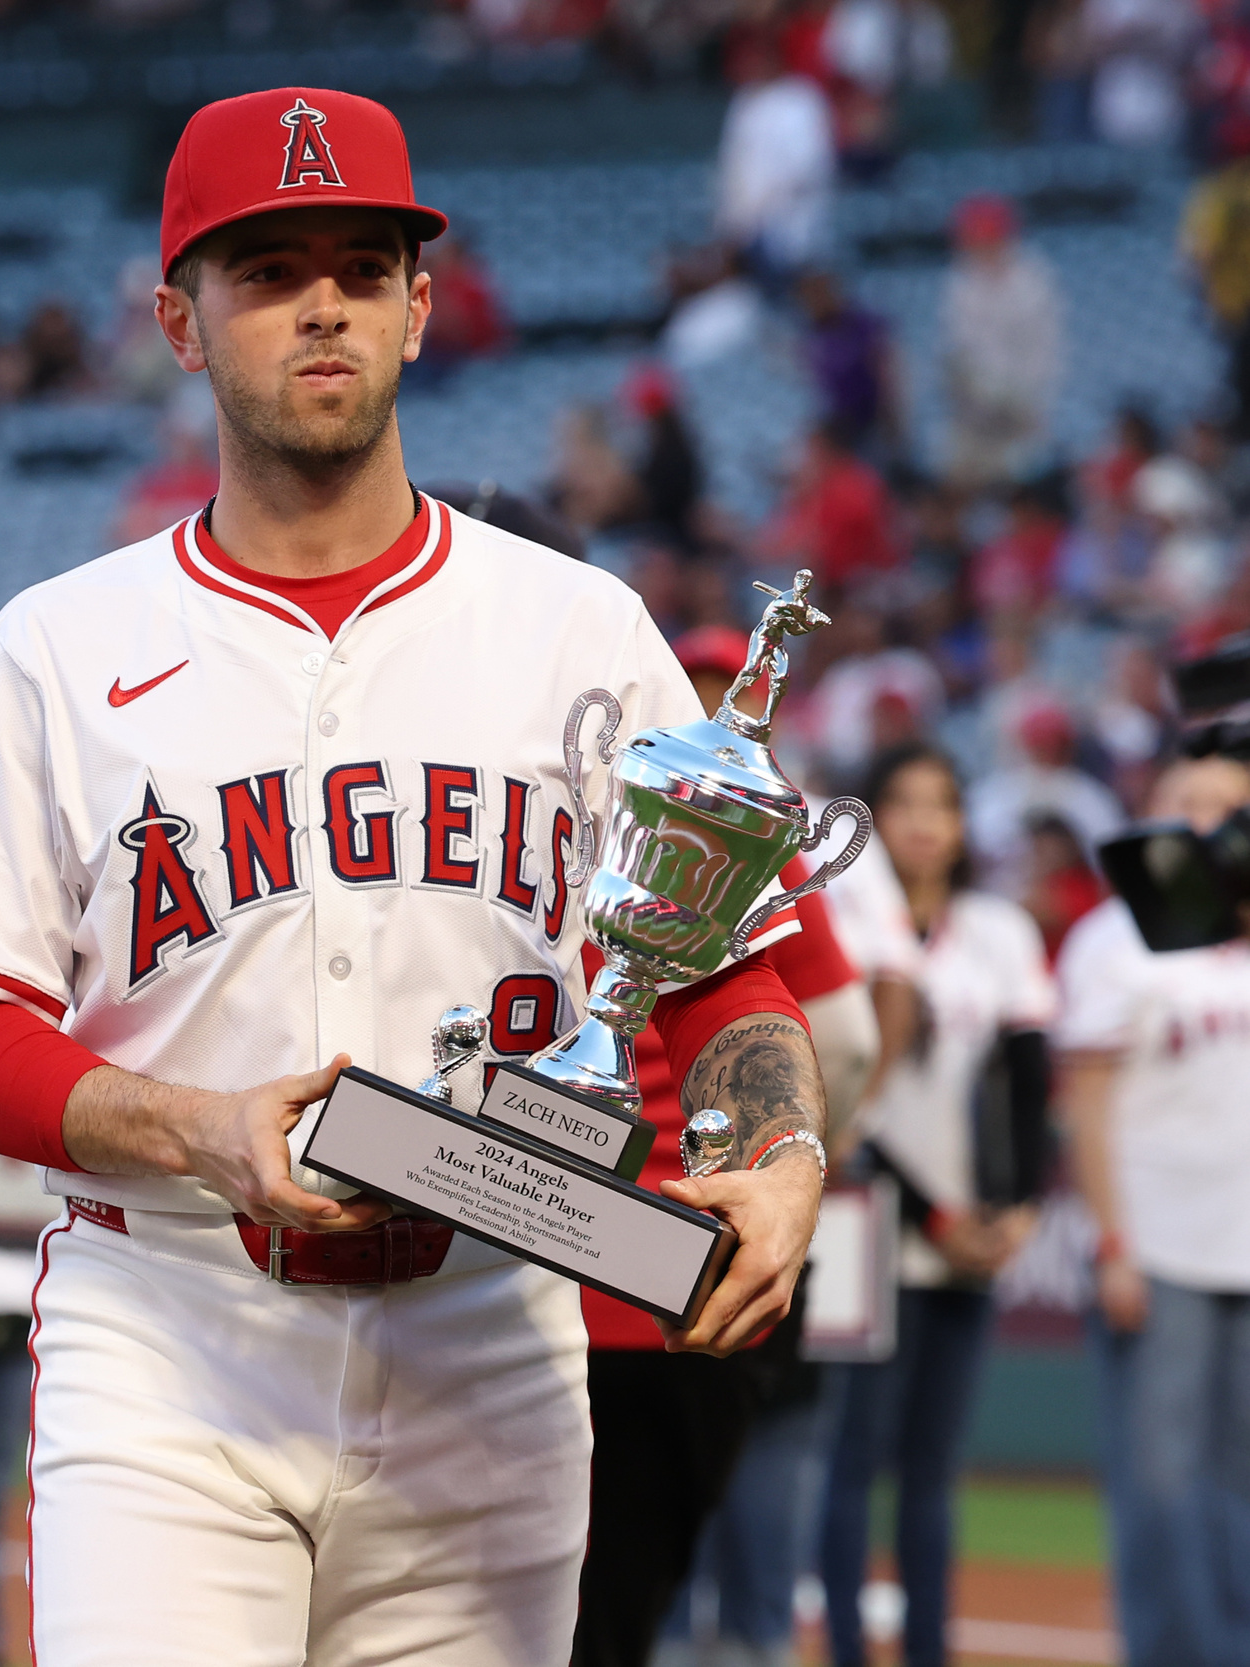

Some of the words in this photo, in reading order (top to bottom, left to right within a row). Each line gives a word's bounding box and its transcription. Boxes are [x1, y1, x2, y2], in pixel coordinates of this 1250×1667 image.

[276, 98, 347, 190] A
[117, 768, 576, 994] ANGELS
[502, 1091, 557, 1126] ZACH
[557, 1113, 609, 1147] NETO
[422, 1165, 460, 1186] Awarded
[460, 1180, 481, 1196] Each
[482, 1189, 511, 1208] Season
[512, 1203, 522, 1213] to
[523, 1207, 536, 1219] the
[537, 1213, 565, 1231] Angels
[566, 1225, 592, 1242] Player
[434, 1145, 477, 1175] Most
[482, 1163, 543, 1203] Valuable
[546, 1192, 595, 1224] Player
[475, 1141, 514, 1167] 2024
[515, 1159, 569, 1191] Angels
[406, 1170, 426, 1185] Who
[427, 1179, 474, 1206] Exemplifies
[475, 1200, 521, 1227] Leadership,
[522, 1220, 583, 1253] Sportsmanship
[583, 1248, 601, 1259] and
[458, 1206, 508, 1234] Professional
[508, 1228, 537, 1247] Ability
